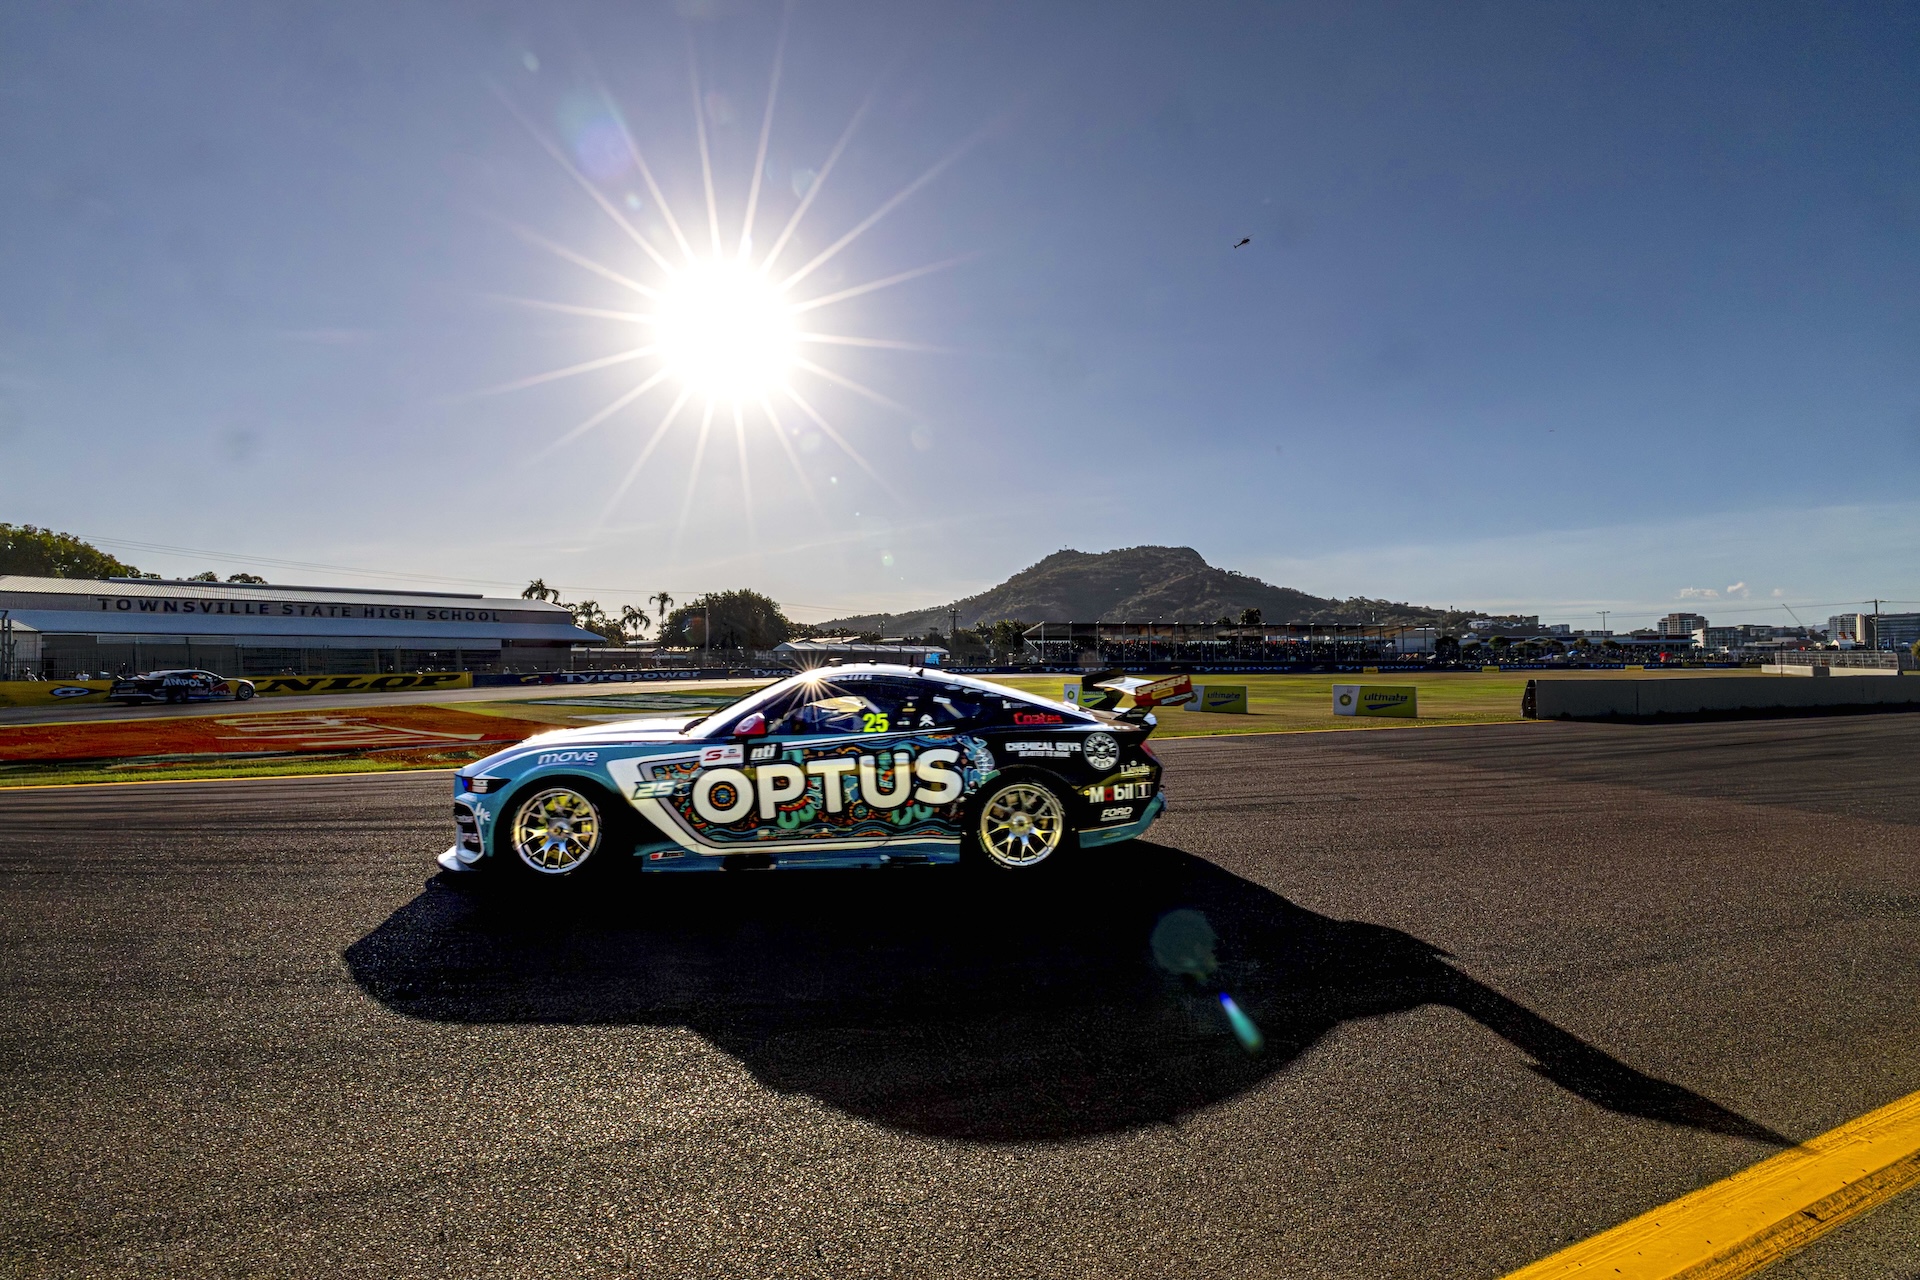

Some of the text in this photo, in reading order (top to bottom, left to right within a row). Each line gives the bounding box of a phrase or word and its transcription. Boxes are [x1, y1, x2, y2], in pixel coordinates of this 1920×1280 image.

[97, 598, 500, 622] TOWNSVILLE STATE HIGH SCHOOL
[162, 678, 204, 688] AMPOL
[560, 670, 702, 684] Tyrepower
[1207, 691, 1240, 699] ultimate
[1364, 693, 1408, 702] ultimate
[863, 713, 890, 733] 25
[1056, 742, 1082, 752] GUYS
[538, 751, 598, 765] move
[634, 781, 675, 799] 25
[692, 748, 963, 825] OPTUS
[1089, 784, 1133, 803] Mobil
[1101, 807, 1133, 818] FORD
